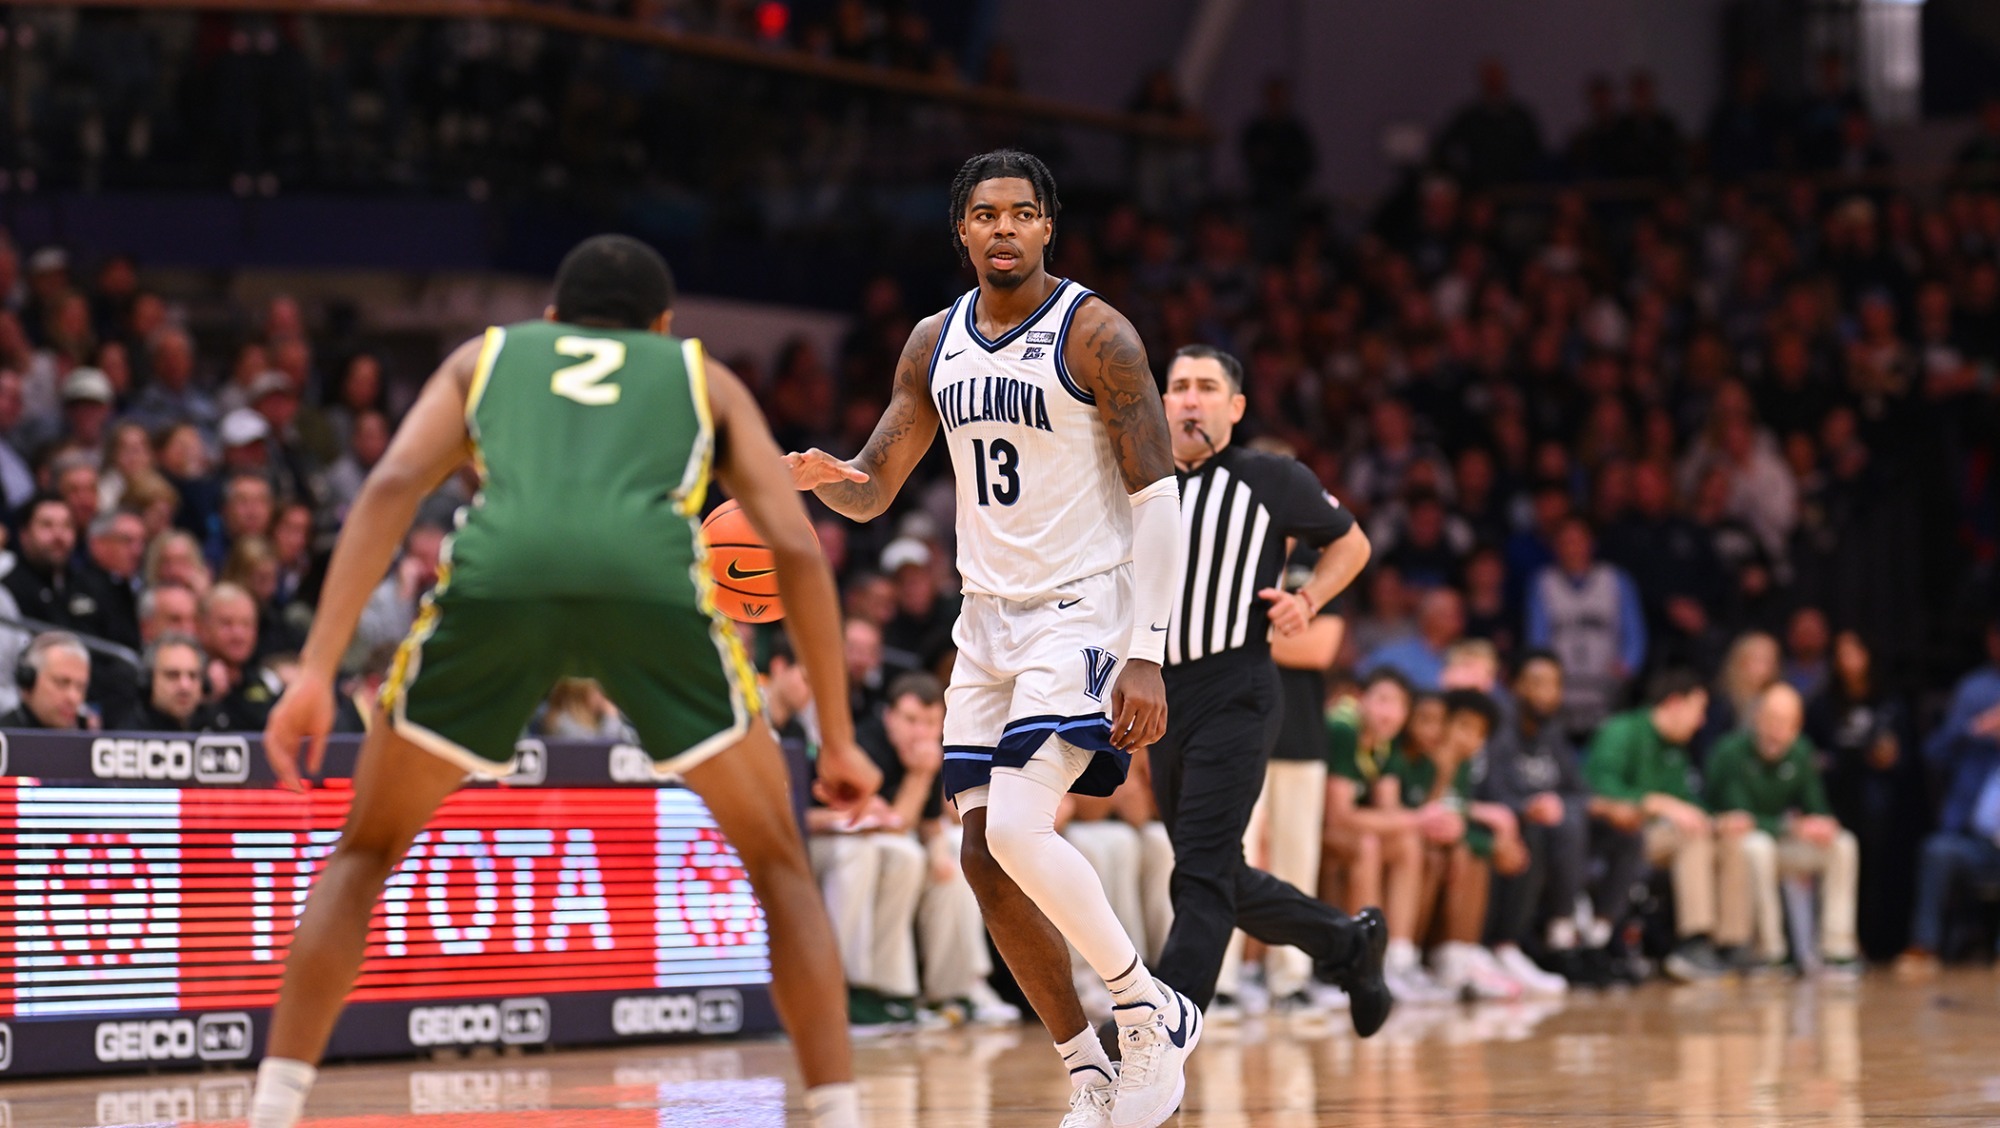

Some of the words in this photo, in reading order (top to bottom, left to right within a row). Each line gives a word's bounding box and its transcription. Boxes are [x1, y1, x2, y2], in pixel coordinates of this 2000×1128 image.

[550, 335, 626, 406] 2
[937, 376, 1053, 432] VILLANOVA
[971, 438, 1022, 506] 13
[1080, 646, 1119, 703] V
[91, 738, 193, 778] GEICO
[408, 1004, 501, 1046] GEICO
[612, 995, 697, 1035] GEICO
[95, 1019, 196, 1062] GEICO
